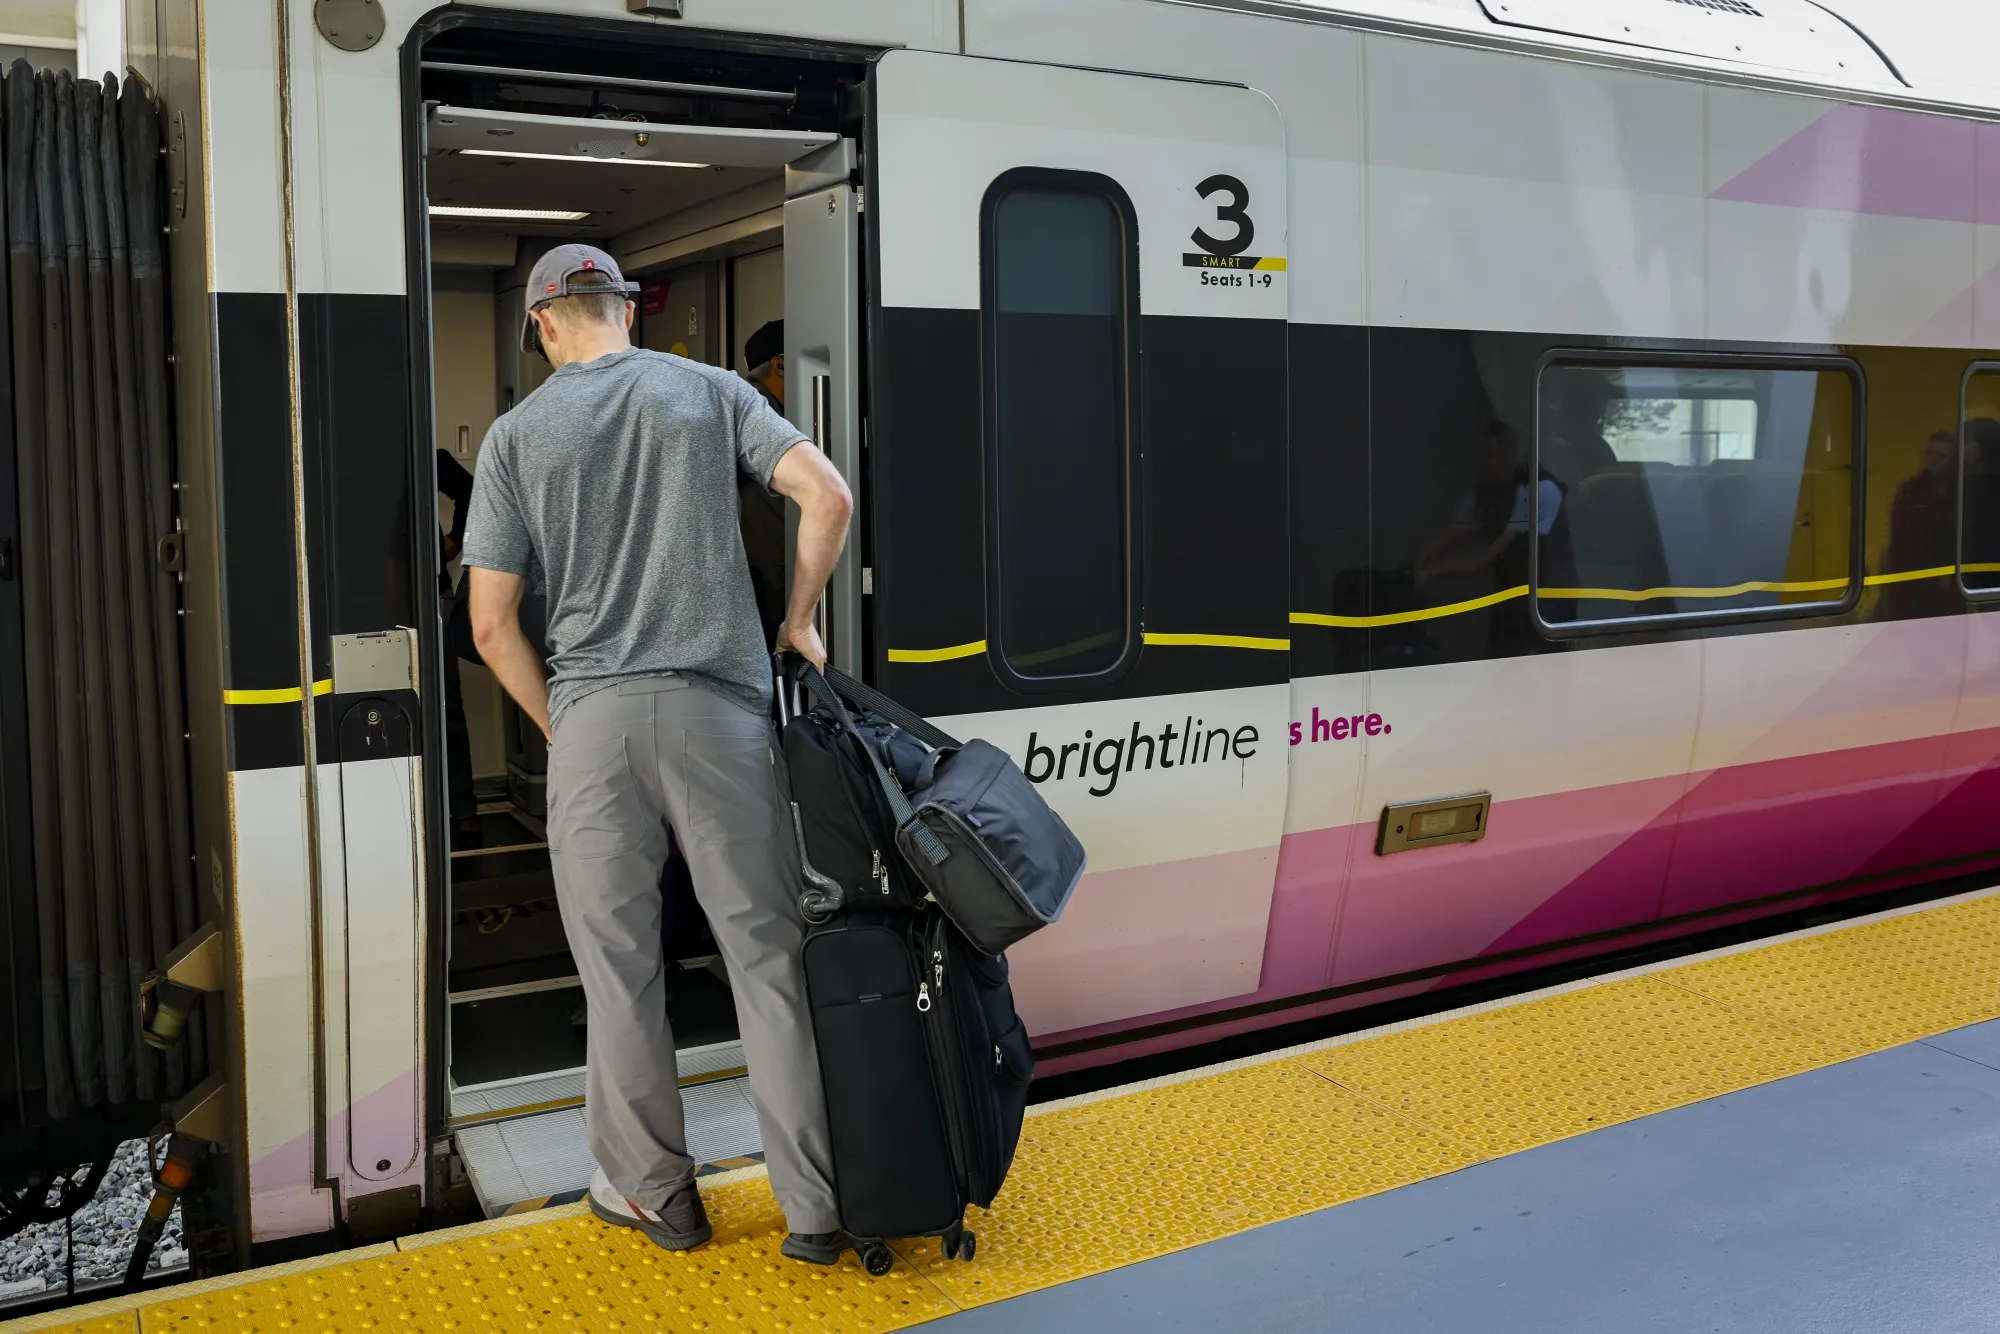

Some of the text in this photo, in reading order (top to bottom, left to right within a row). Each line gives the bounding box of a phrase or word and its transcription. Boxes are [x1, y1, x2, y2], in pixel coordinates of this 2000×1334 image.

[1190, 174, 1255, 256] 3
[1200, 271, 1272, 288] Seats 1-9
[1202, 256, 1240, 268] SMART
[1311, 707, 1392, 743] here.
[1023, 715, 1259, 797] brightline
